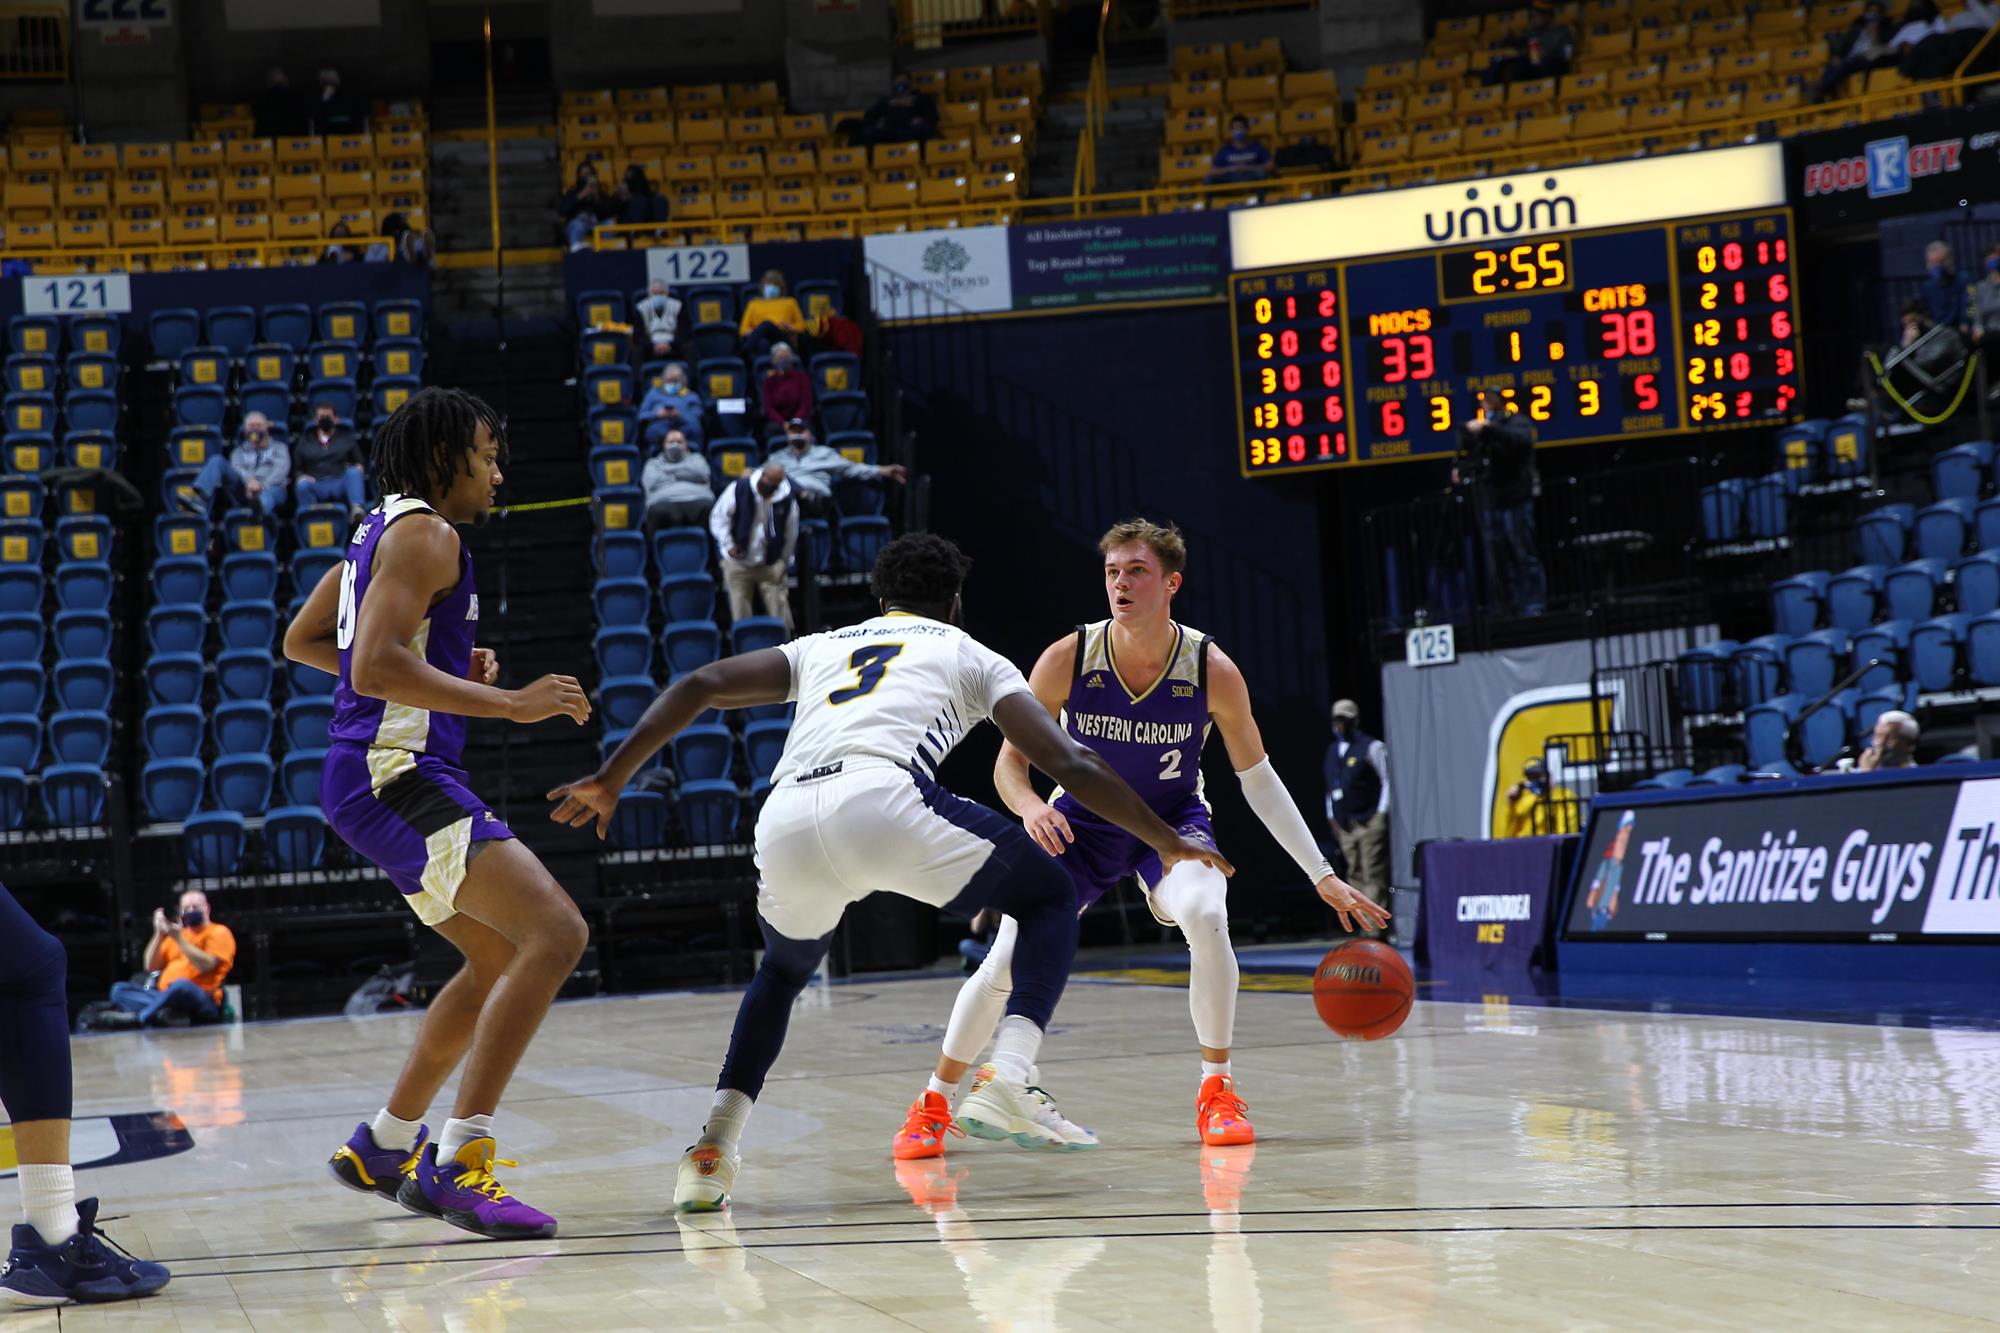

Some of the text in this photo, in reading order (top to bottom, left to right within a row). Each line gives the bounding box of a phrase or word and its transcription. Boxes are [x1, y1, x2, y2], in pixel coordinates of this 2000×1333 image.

[1805, 156, 1869, 197] FOOD
[1908, 138, 1964, 178] CITY
[667, 250, 730, 279] 122
[1473, 242, 1565, 294] 2:55
[1698, 239, 1786, 273] 0 0 11
[45, 279, 107, 309] 121
[1255, 290, 1336, 324] 0 1 2
[1584, 284, 1646, 312] CATS
[1700, 274, 1789, 310] 2 1 6
[1369, 308, 1431, 336] MOCS
[1602, 309, 1656, 359] 38
[1694, 311, 1791, 346] 12 1 6
[1257, 325, 1338, 359] 2 0 2
[1381, 335, 1435, 382] 33
[1509, 331, 1521, 362] 1
[1261, 360, 1341, 394] 3 0 0
[1688, 356, 1724, 385] 21
[1730, 352, 1751, 381] 0
[1254, 395, 1343, 429] 13 0 6
[1381, 400, 1405, 437] 6
[1429, 395, 1451, 431] 3
[1530, 384, 1552, 421] 2
[1577, 379, 1600, 417] 3
[1633, 373, 1660, 411] 5
[1251, 432, 1346, 465] 33 0 11
[1413, 630, 1450, 660] 125
[827, 642, 906, 707] 3
[1075, 712, 1192, 745] WESTERN CAROLINA
[1159, 749, 1182, 780] 2
[1633, 822, 2000, 925] The Sanitize Guys Th
